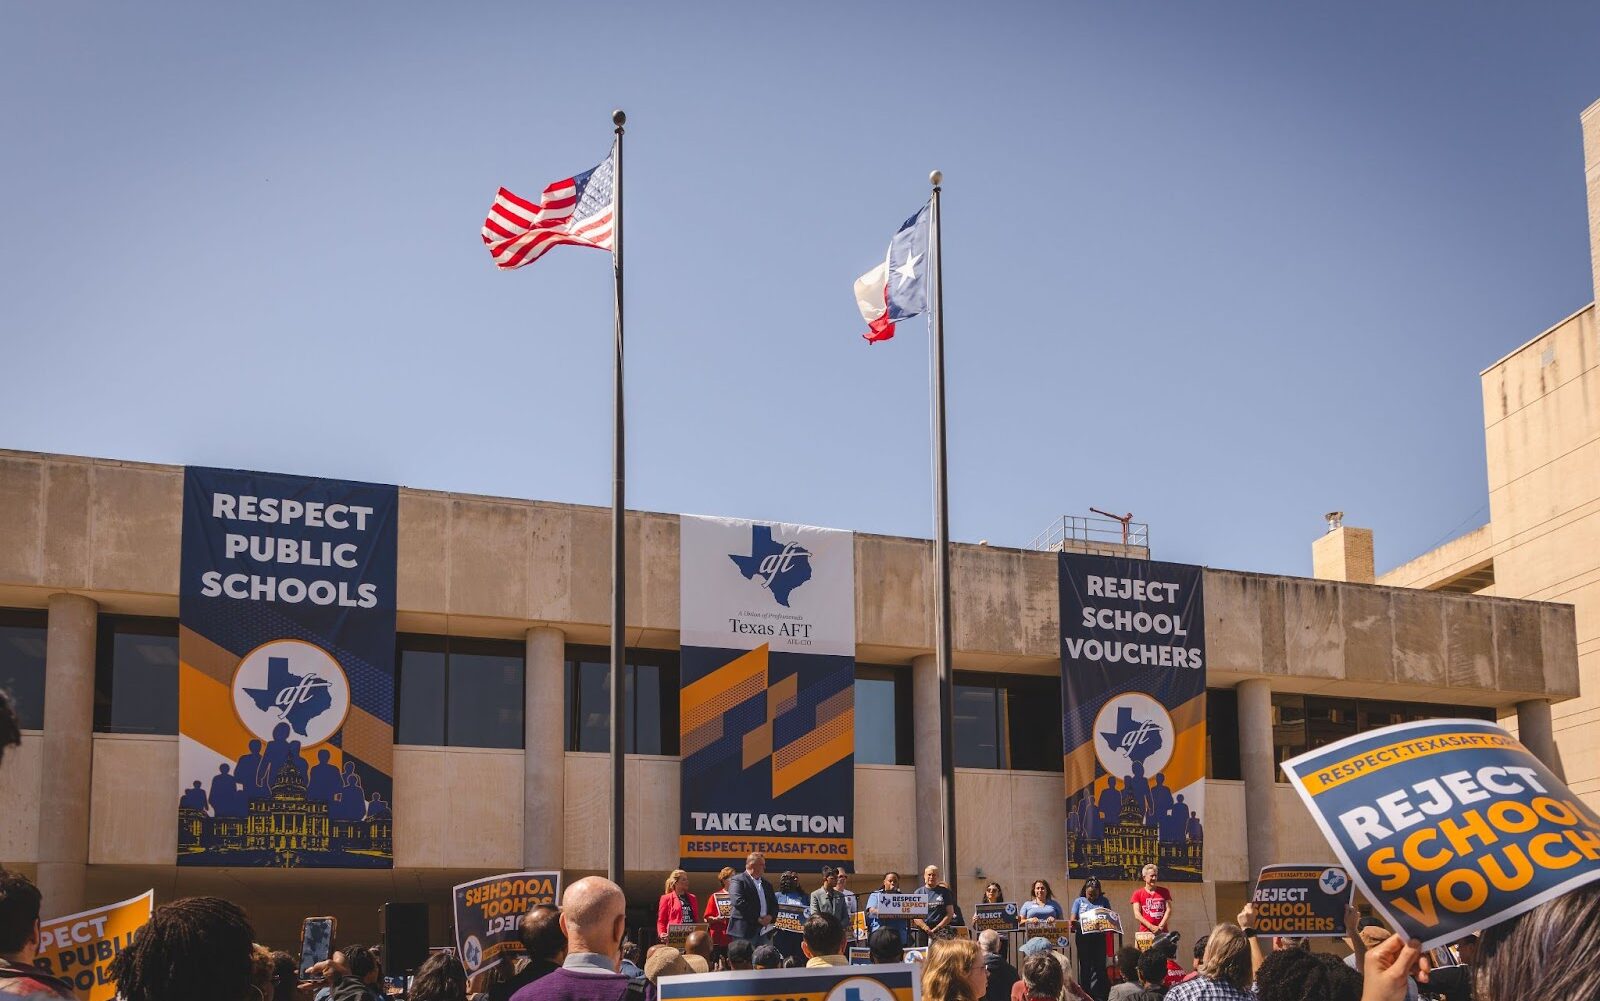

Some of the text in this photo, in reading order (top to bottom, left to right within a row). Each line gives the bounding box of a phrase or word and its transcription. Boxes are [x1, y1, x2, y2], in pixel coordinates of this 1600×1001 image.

[213, 493, 373, 530] RESPECT
[225, 534, 358, 568] PUBLIC
[759, 541, 813, 589] aft
[201, 571, 377, 609] SCHOOLS
[1087, 574, 1179, 603] REJECT
[728, 618, 812, 638] Texas AFT
[1082, 606, 1187, 636] SCHOOL
[1065, 637, 1203, 669] VOUCHERS
[275, 672, 332, 720] aft
[1121, 719, 1163, 758] aft
[691, 812, 845, 833] TAKE ACTION
[1338, 766, 1548, 850] REJECT
[687, 841, 848, 855] RESPECT.TEXASAFT.ORG
[1367, 796, 1600, 891] SCHOOL
[465, 879, 554, 907] VOUCHERS
[1390, 829, 1600, 928] VOUCH
[1252, 903, 1315, 916] SCHOOL
[1253, 888, 1308, 902] REJECT
[486, 915, 523, 937] JECT
[776, 917, 801, 925] CHOOL
[777, 911, 799, 919] EJECT
[1253, 917, 1334, 931] VOUCHERS
[39, 916, 108, 954] PECT
